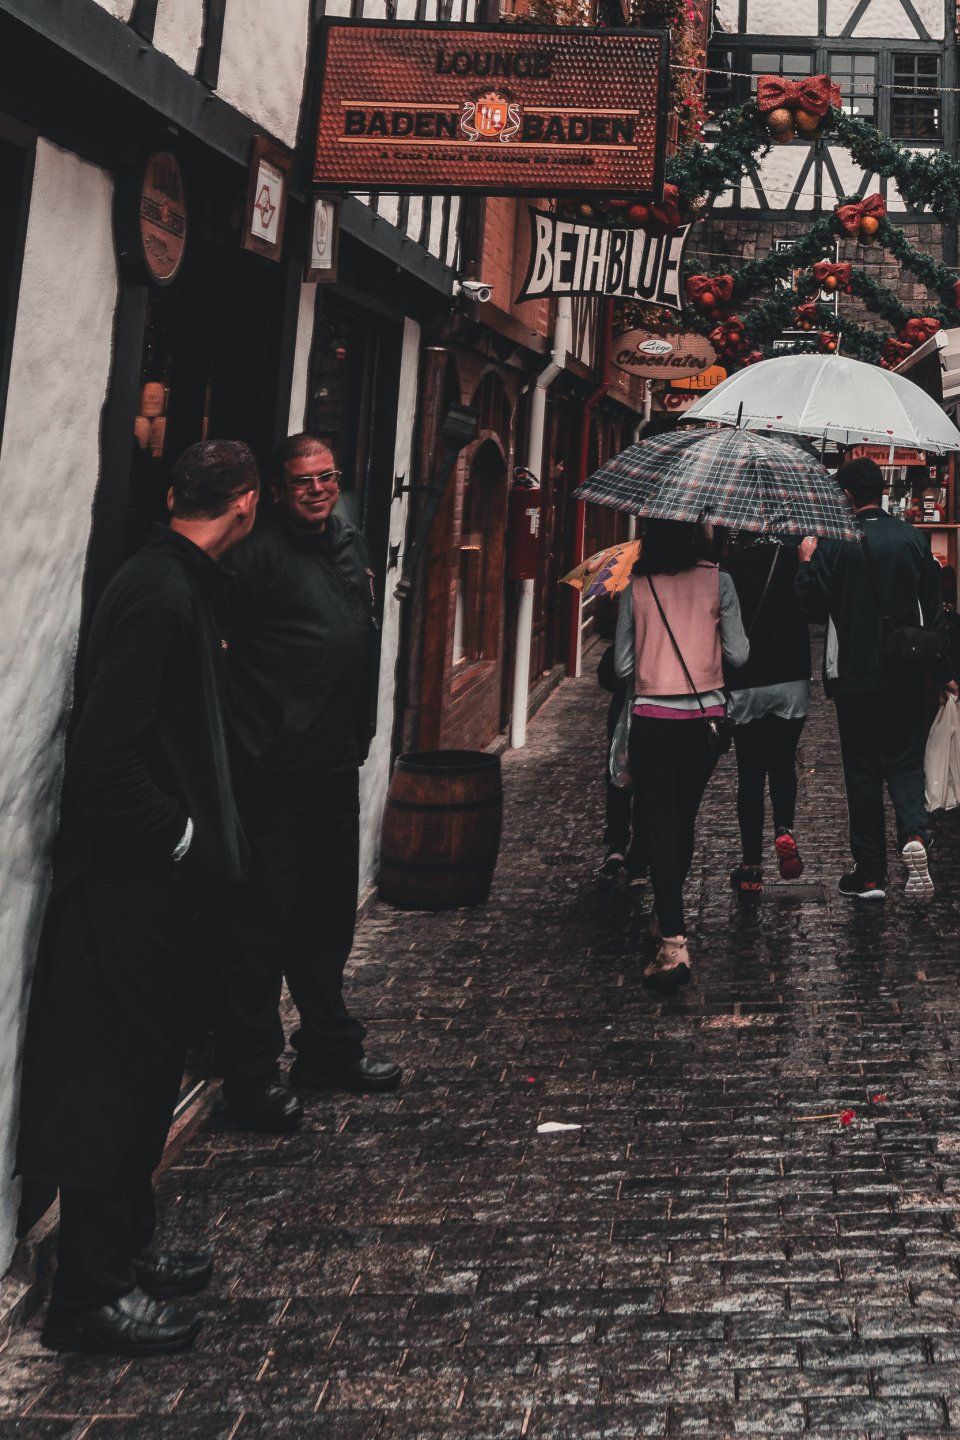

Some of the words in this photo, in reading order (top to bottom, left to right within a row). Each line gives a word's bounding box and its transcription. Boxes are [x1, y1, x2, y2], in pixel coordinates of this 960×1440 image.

[436, 50, 552, 78] LOUNGE
[344, 109, 458, 138] BADEN
[521, 113, 635, 144] BADEN
[616, 349, 707, 369] Chocolates
